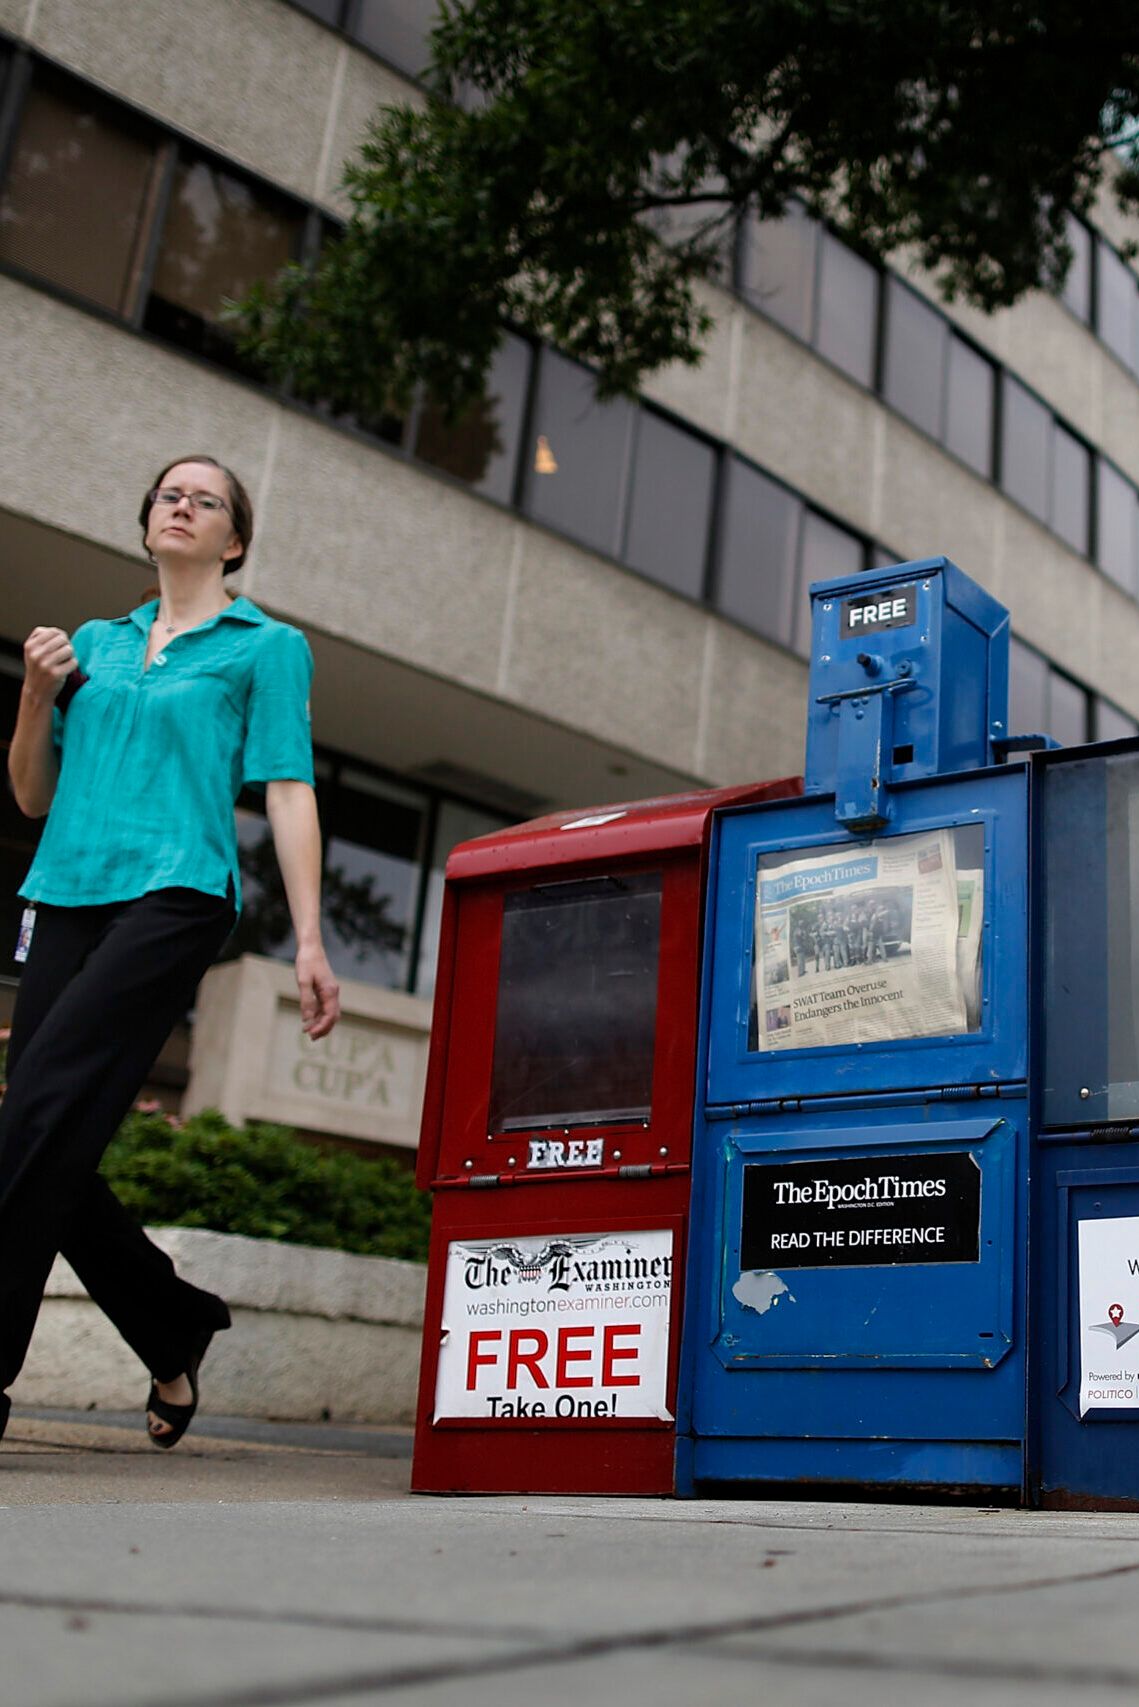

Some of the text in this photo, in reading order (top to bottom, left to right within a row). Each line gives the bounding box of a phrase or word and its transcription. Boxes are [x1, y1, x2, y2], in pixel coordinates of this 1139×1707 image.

[849, 598, 907, 627] FREE
[774, 880, 794, 895] The
[793, 979, 888, 1009] SWAT Team Overuse
[794, 989, 903, 1022] Endangers the Innocent
[527, 1138, 604, 1169] FREE
[773, 1181, 813, 1205] The
[771, 1227, 946, 1250] READ THE DIFFERENCE
[464, 1248, 673, 1293] The Examiner
[585, 1280, 671, 1293] WASHINGTON
[466, 1292, 668, 1317] washingtonexaminer.com
[466, 1324, 642, 1391] FREE
[1088, 1371, 1123, 1382] Powered
[1124, 1370, 1135, 1382] by
[486, 1393, 618, 1418] Take One!
[1088, 1389, 1133, 1400] POLITICO
